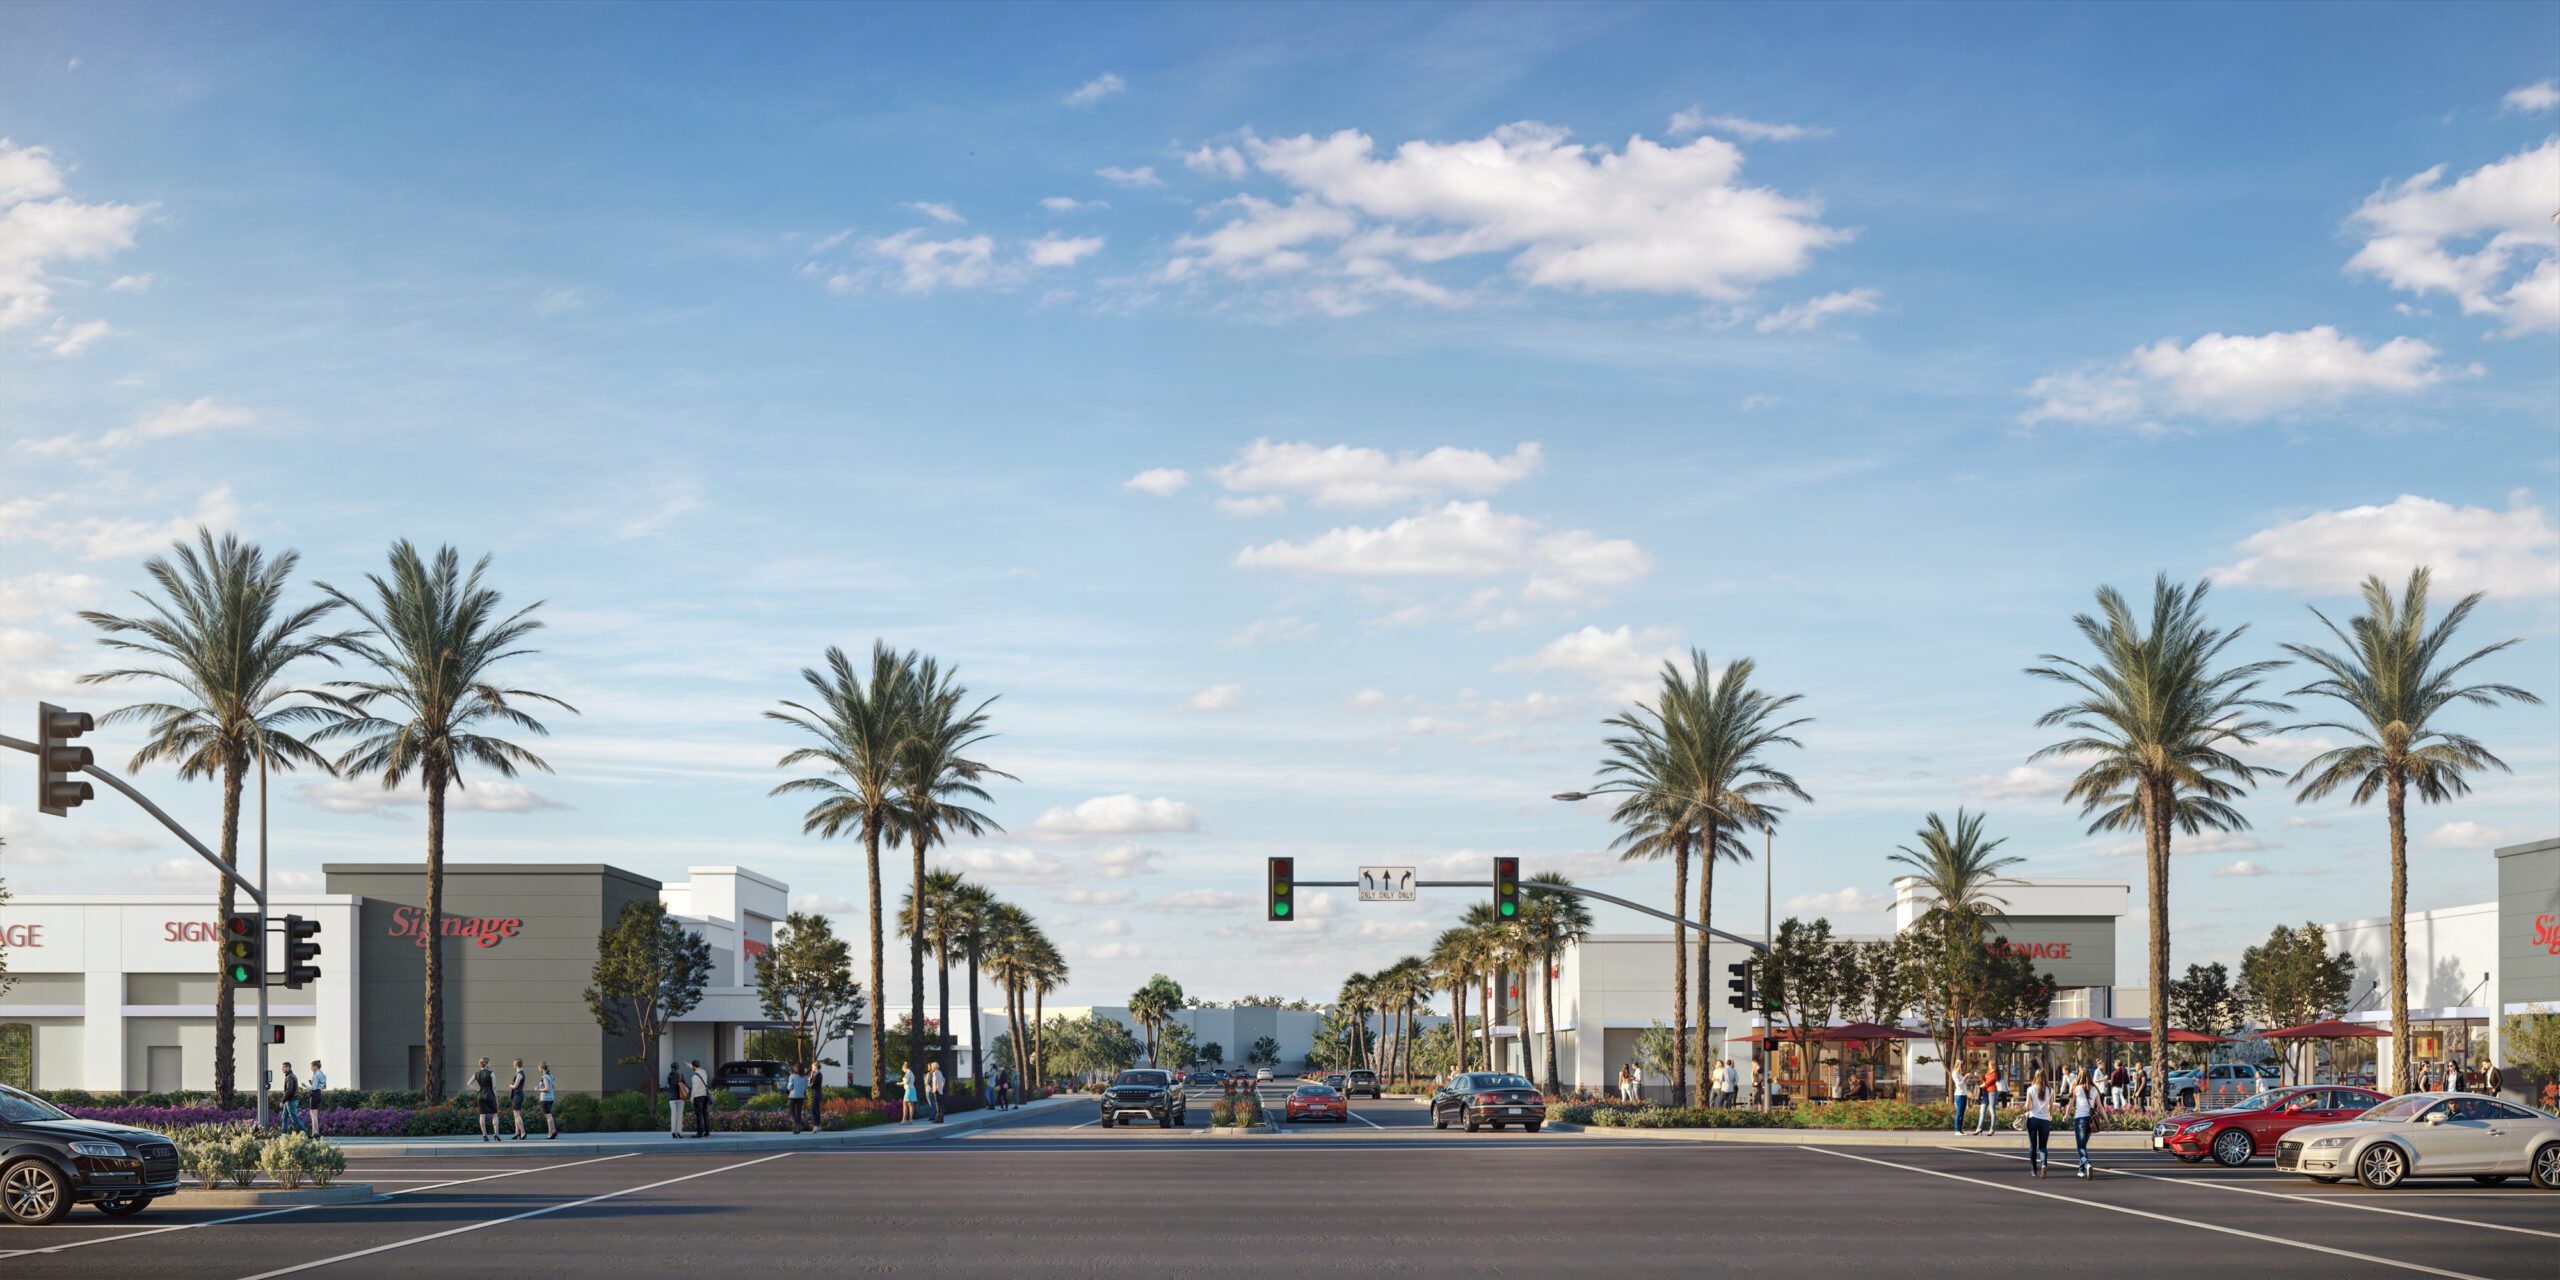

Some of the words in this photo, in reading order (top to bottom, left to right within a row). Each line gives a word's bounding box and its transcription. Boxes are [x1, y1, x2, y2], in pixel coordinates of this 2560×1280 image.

[1361, 891, 1376, 899] ONLY
[1379, 891, 1394, 899] ONLY
[1398, 891, 1413, 899] ONLY
